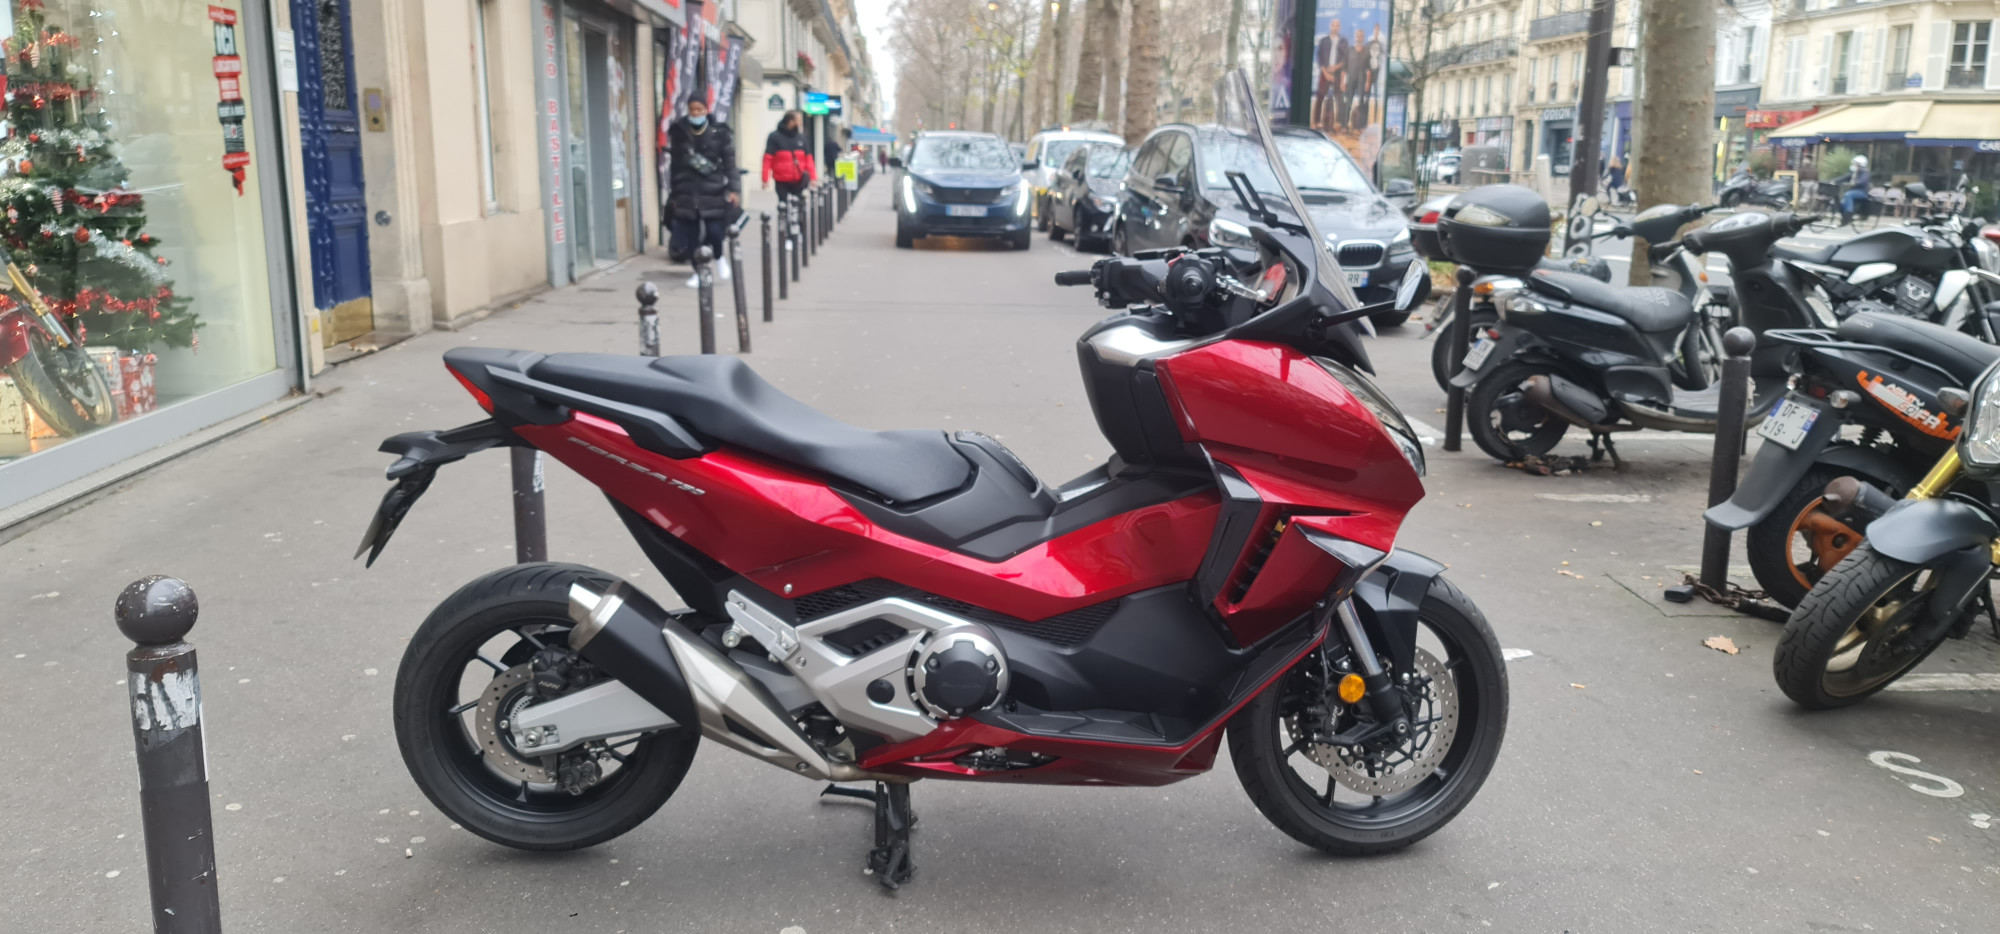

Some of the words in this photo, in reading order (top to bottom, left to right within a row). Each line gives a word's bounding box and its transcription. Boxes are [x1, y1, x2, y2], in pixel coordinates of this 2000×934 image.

[542, 4, 557, 79] MOTO
[1544, 108, 1571, 120] ODEON
[547, 101, 566, 244] BASTILLE
[567, 436, 668, 483] FORZA
